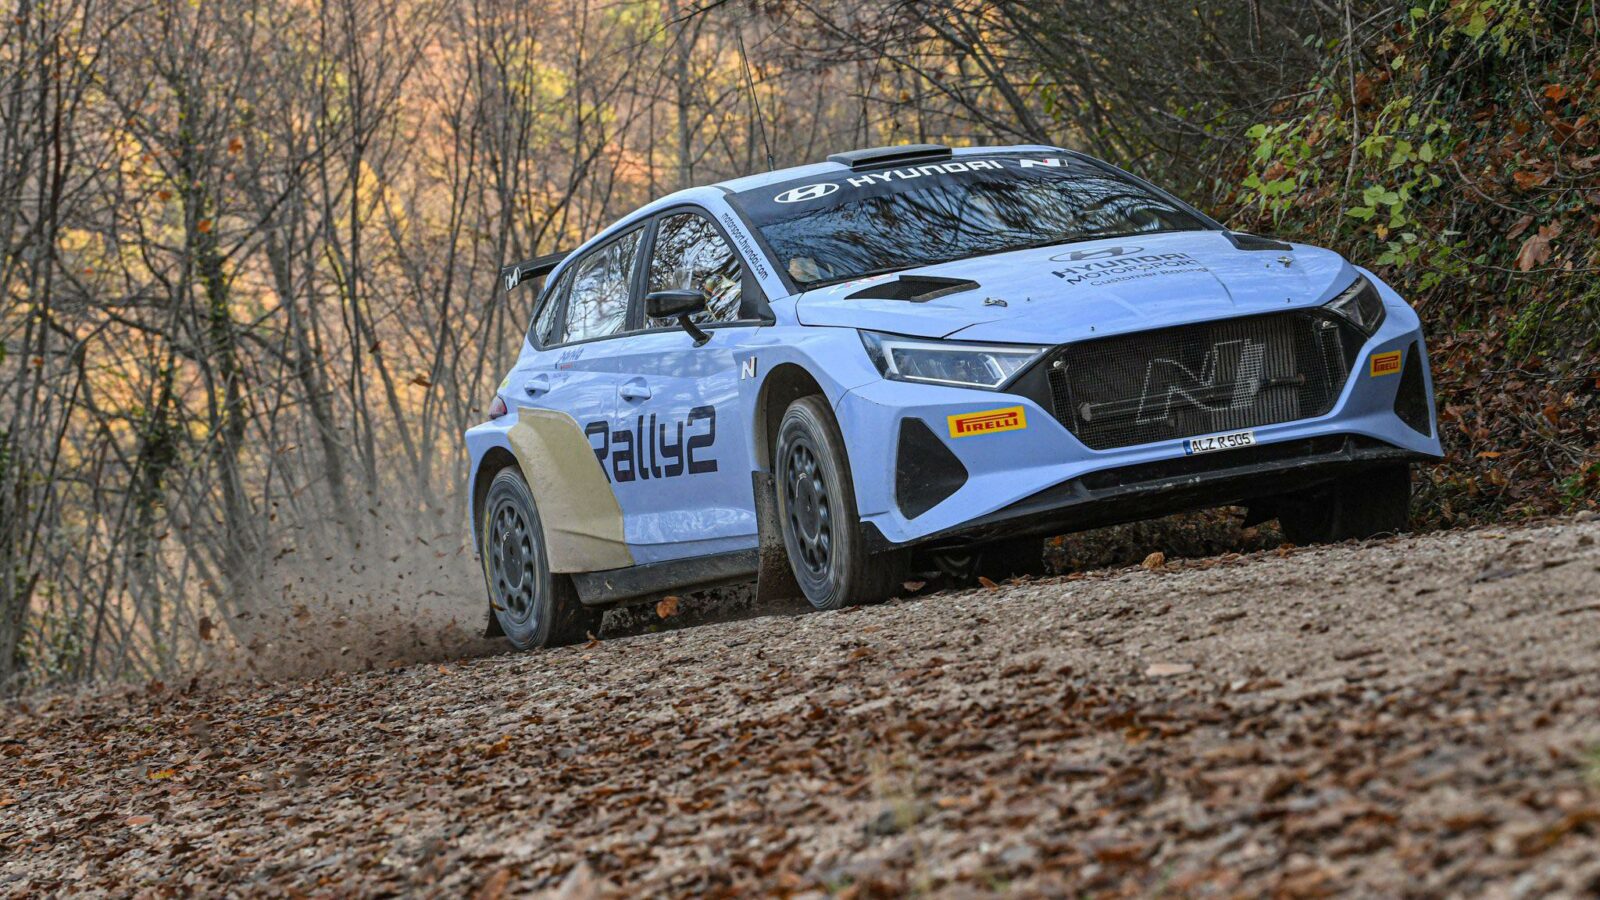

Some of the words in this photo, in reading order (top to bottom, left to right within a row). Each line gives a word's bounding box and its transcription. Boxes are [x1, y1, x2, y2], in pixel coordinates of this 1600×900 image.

[847, 160, 1003, 188] HYUNDAI
[721, 212, 769, 280] motorsport.hyundai.com
[1051, 253, 1190, 279] HYUNDAI
[1066, 260, 1198, 285] MOTORSPORT
[1090, 272, 1157, 286] Customer
[1160, 267, 1209, 276] Racing
[741, 355, 757, 380] N
[956, 412, 1019, 434] PIRELLI
[585, 405, 718, 483] Rally2
[1192, 437, 1217, 452] ALZ
[1217, 436, 1228, 449] R
[1227, 432, 1251, 446] 505
